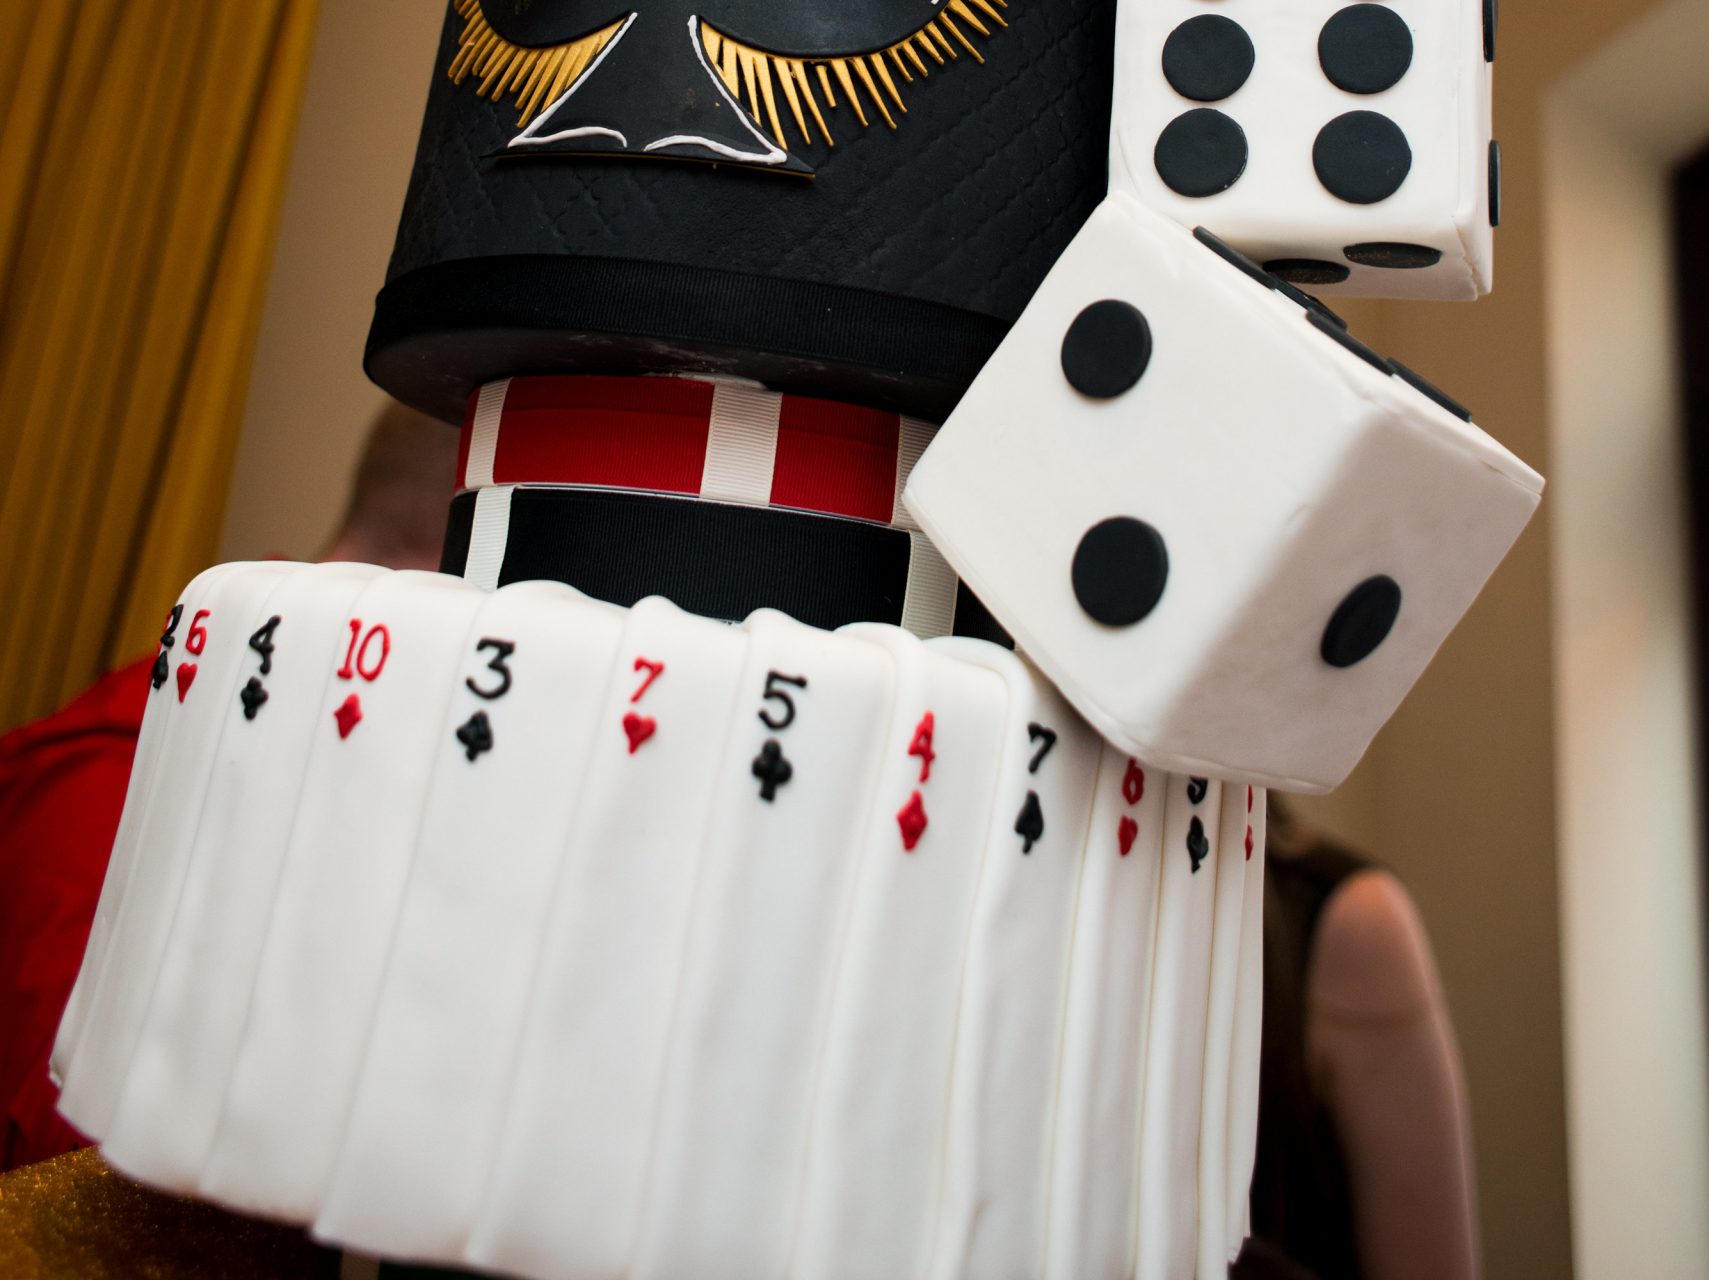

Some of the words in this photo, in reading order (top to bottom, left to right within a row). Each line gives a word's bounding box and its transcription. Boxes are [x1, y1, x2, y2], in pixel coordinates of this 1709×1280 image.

[185, 609, 211, 657] 6
[248, 615, 282, 675] 4
[337, 618, 391, 682] 10
[465, 637, 516, 700] 3
[630, 656, 665, 703] 7
[757, 669, 808, 731] 5
[907, 710, 935, 784] 4
[1027, 721, 1057, 774] 7
